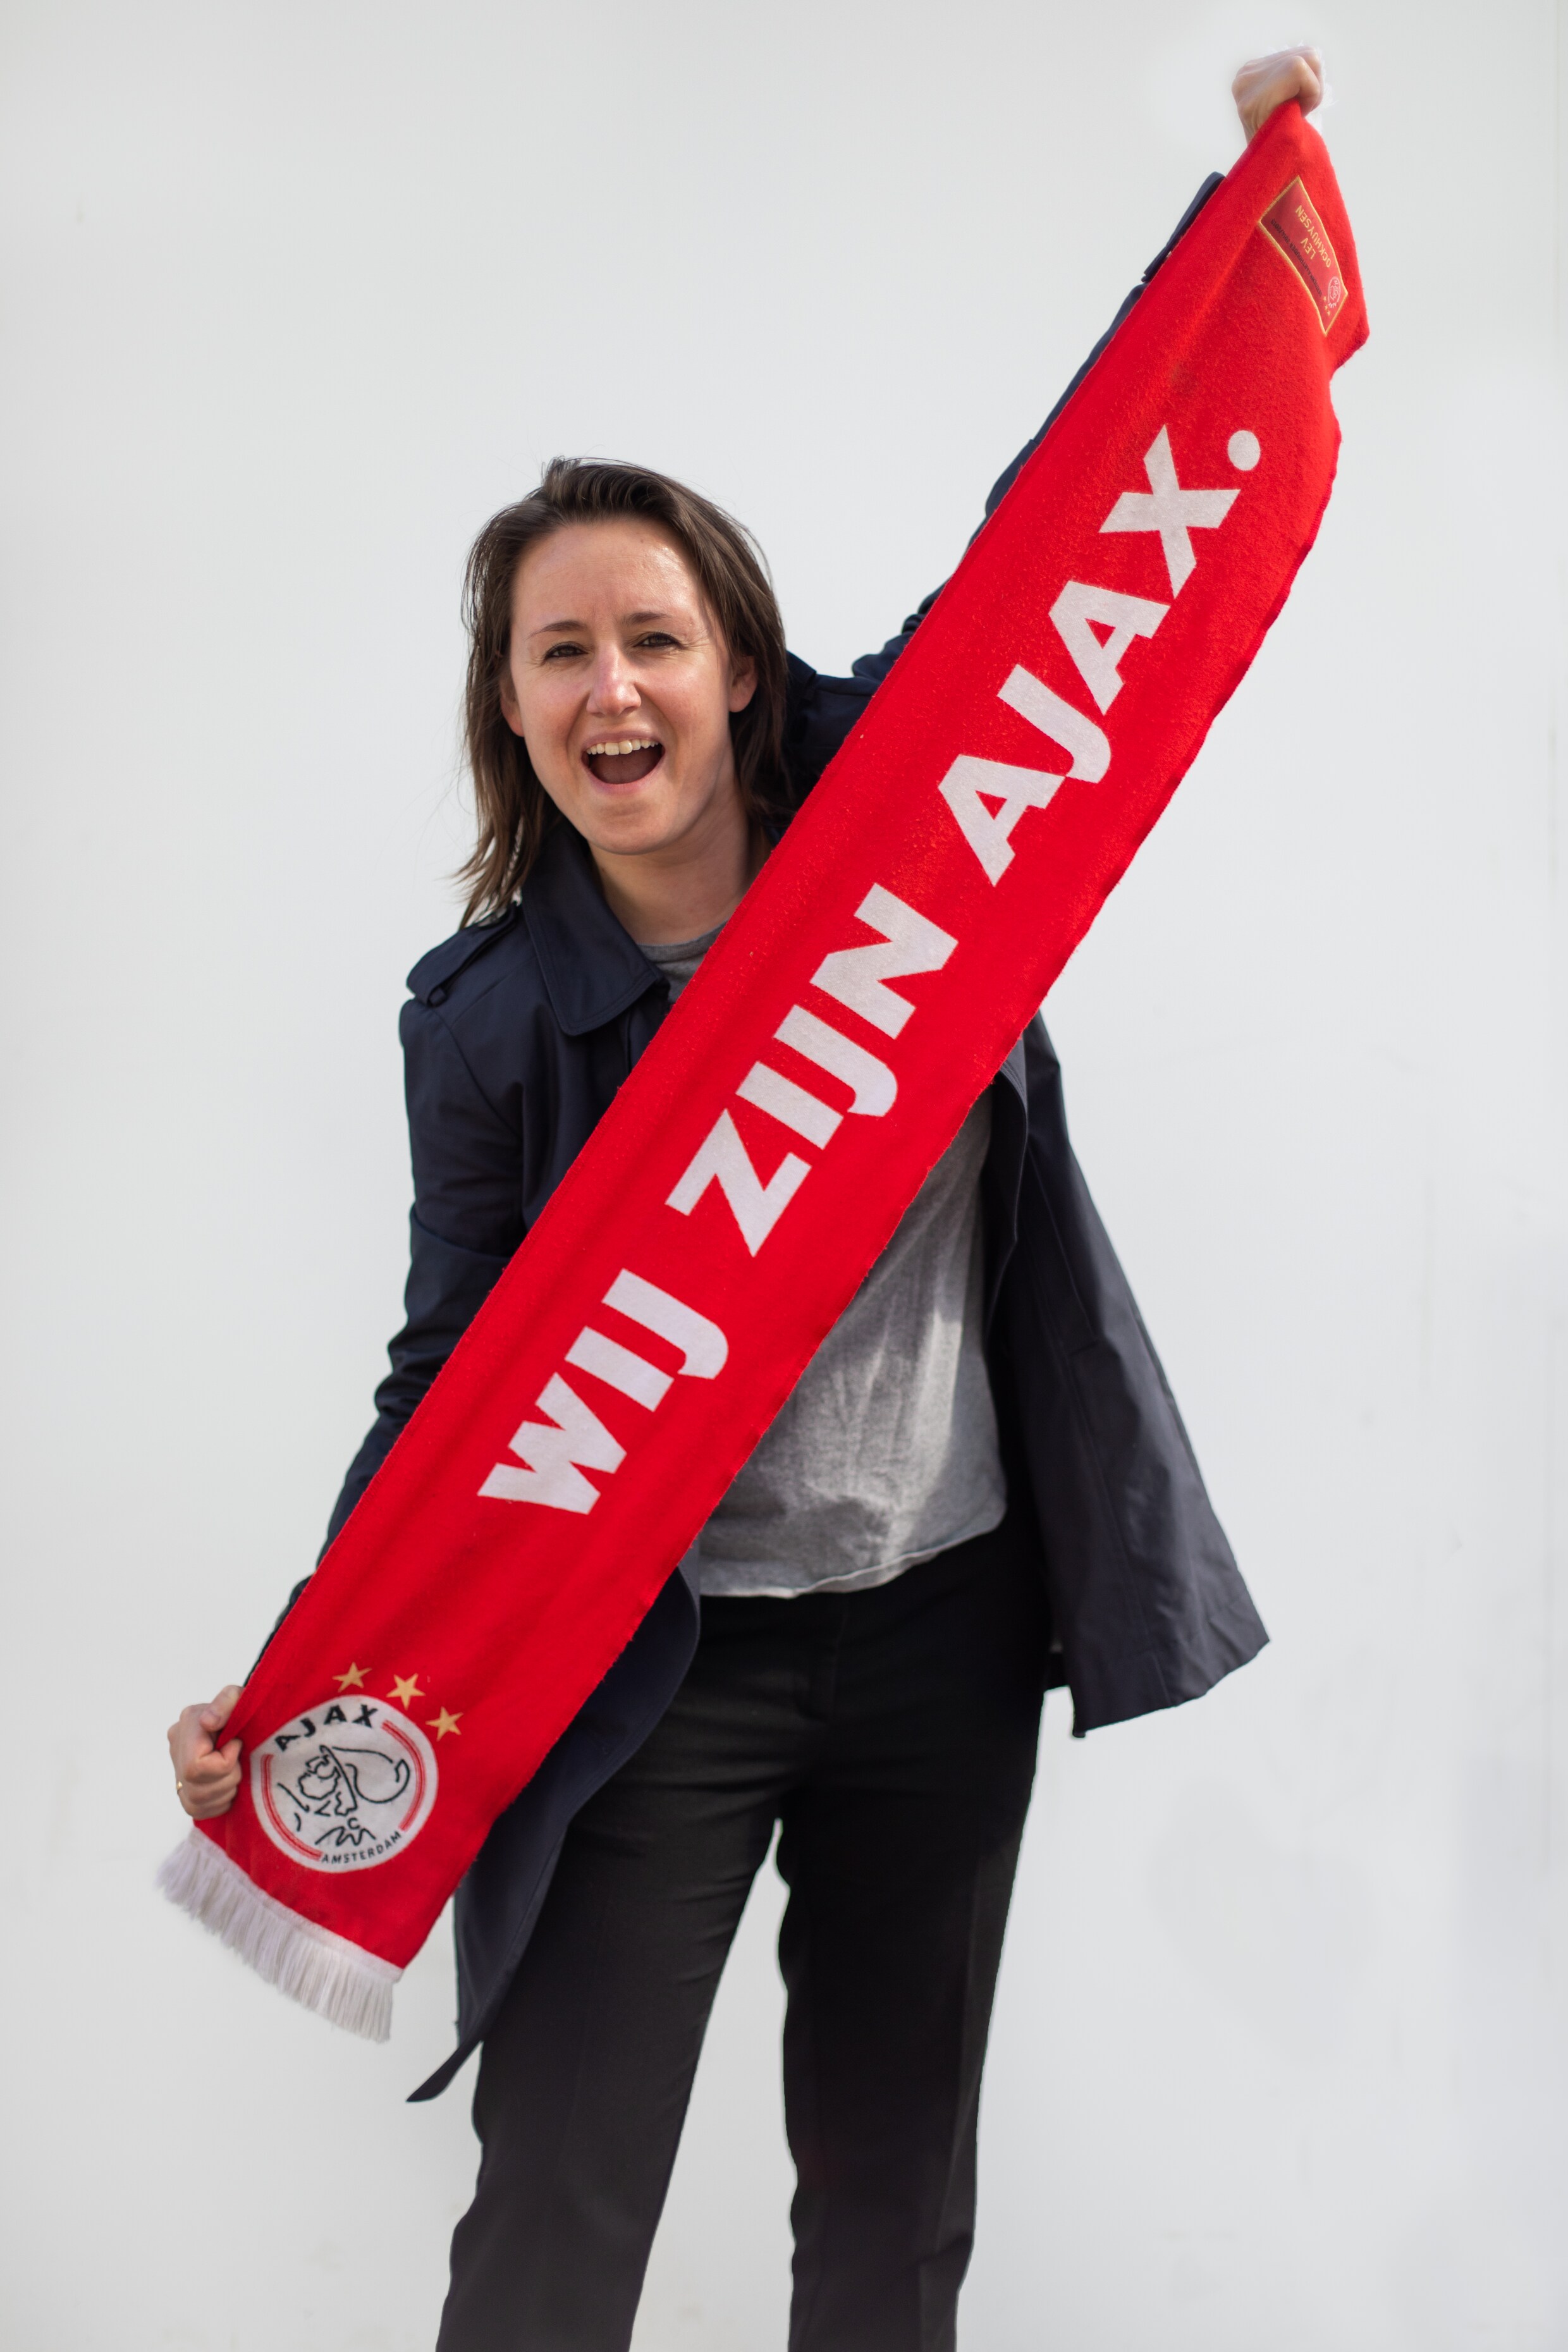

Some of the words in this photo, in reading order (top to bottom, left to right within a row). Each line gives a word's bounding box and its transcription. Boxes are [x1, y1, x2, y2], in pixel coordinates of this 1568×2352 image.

[1295, 204, 1332, 267] OCKHUYSEN
[1301, 237, 1316, 260] LEV
[476, 1267, 729, 1515] WIJ
[664, 882, 959, 1258] ZIJN
[938, 423, 1261, 888] AJAX.
[275, 1704, 378, 1752] AJAX
[321, 1831, 402, 1865] AMSTERDAM
